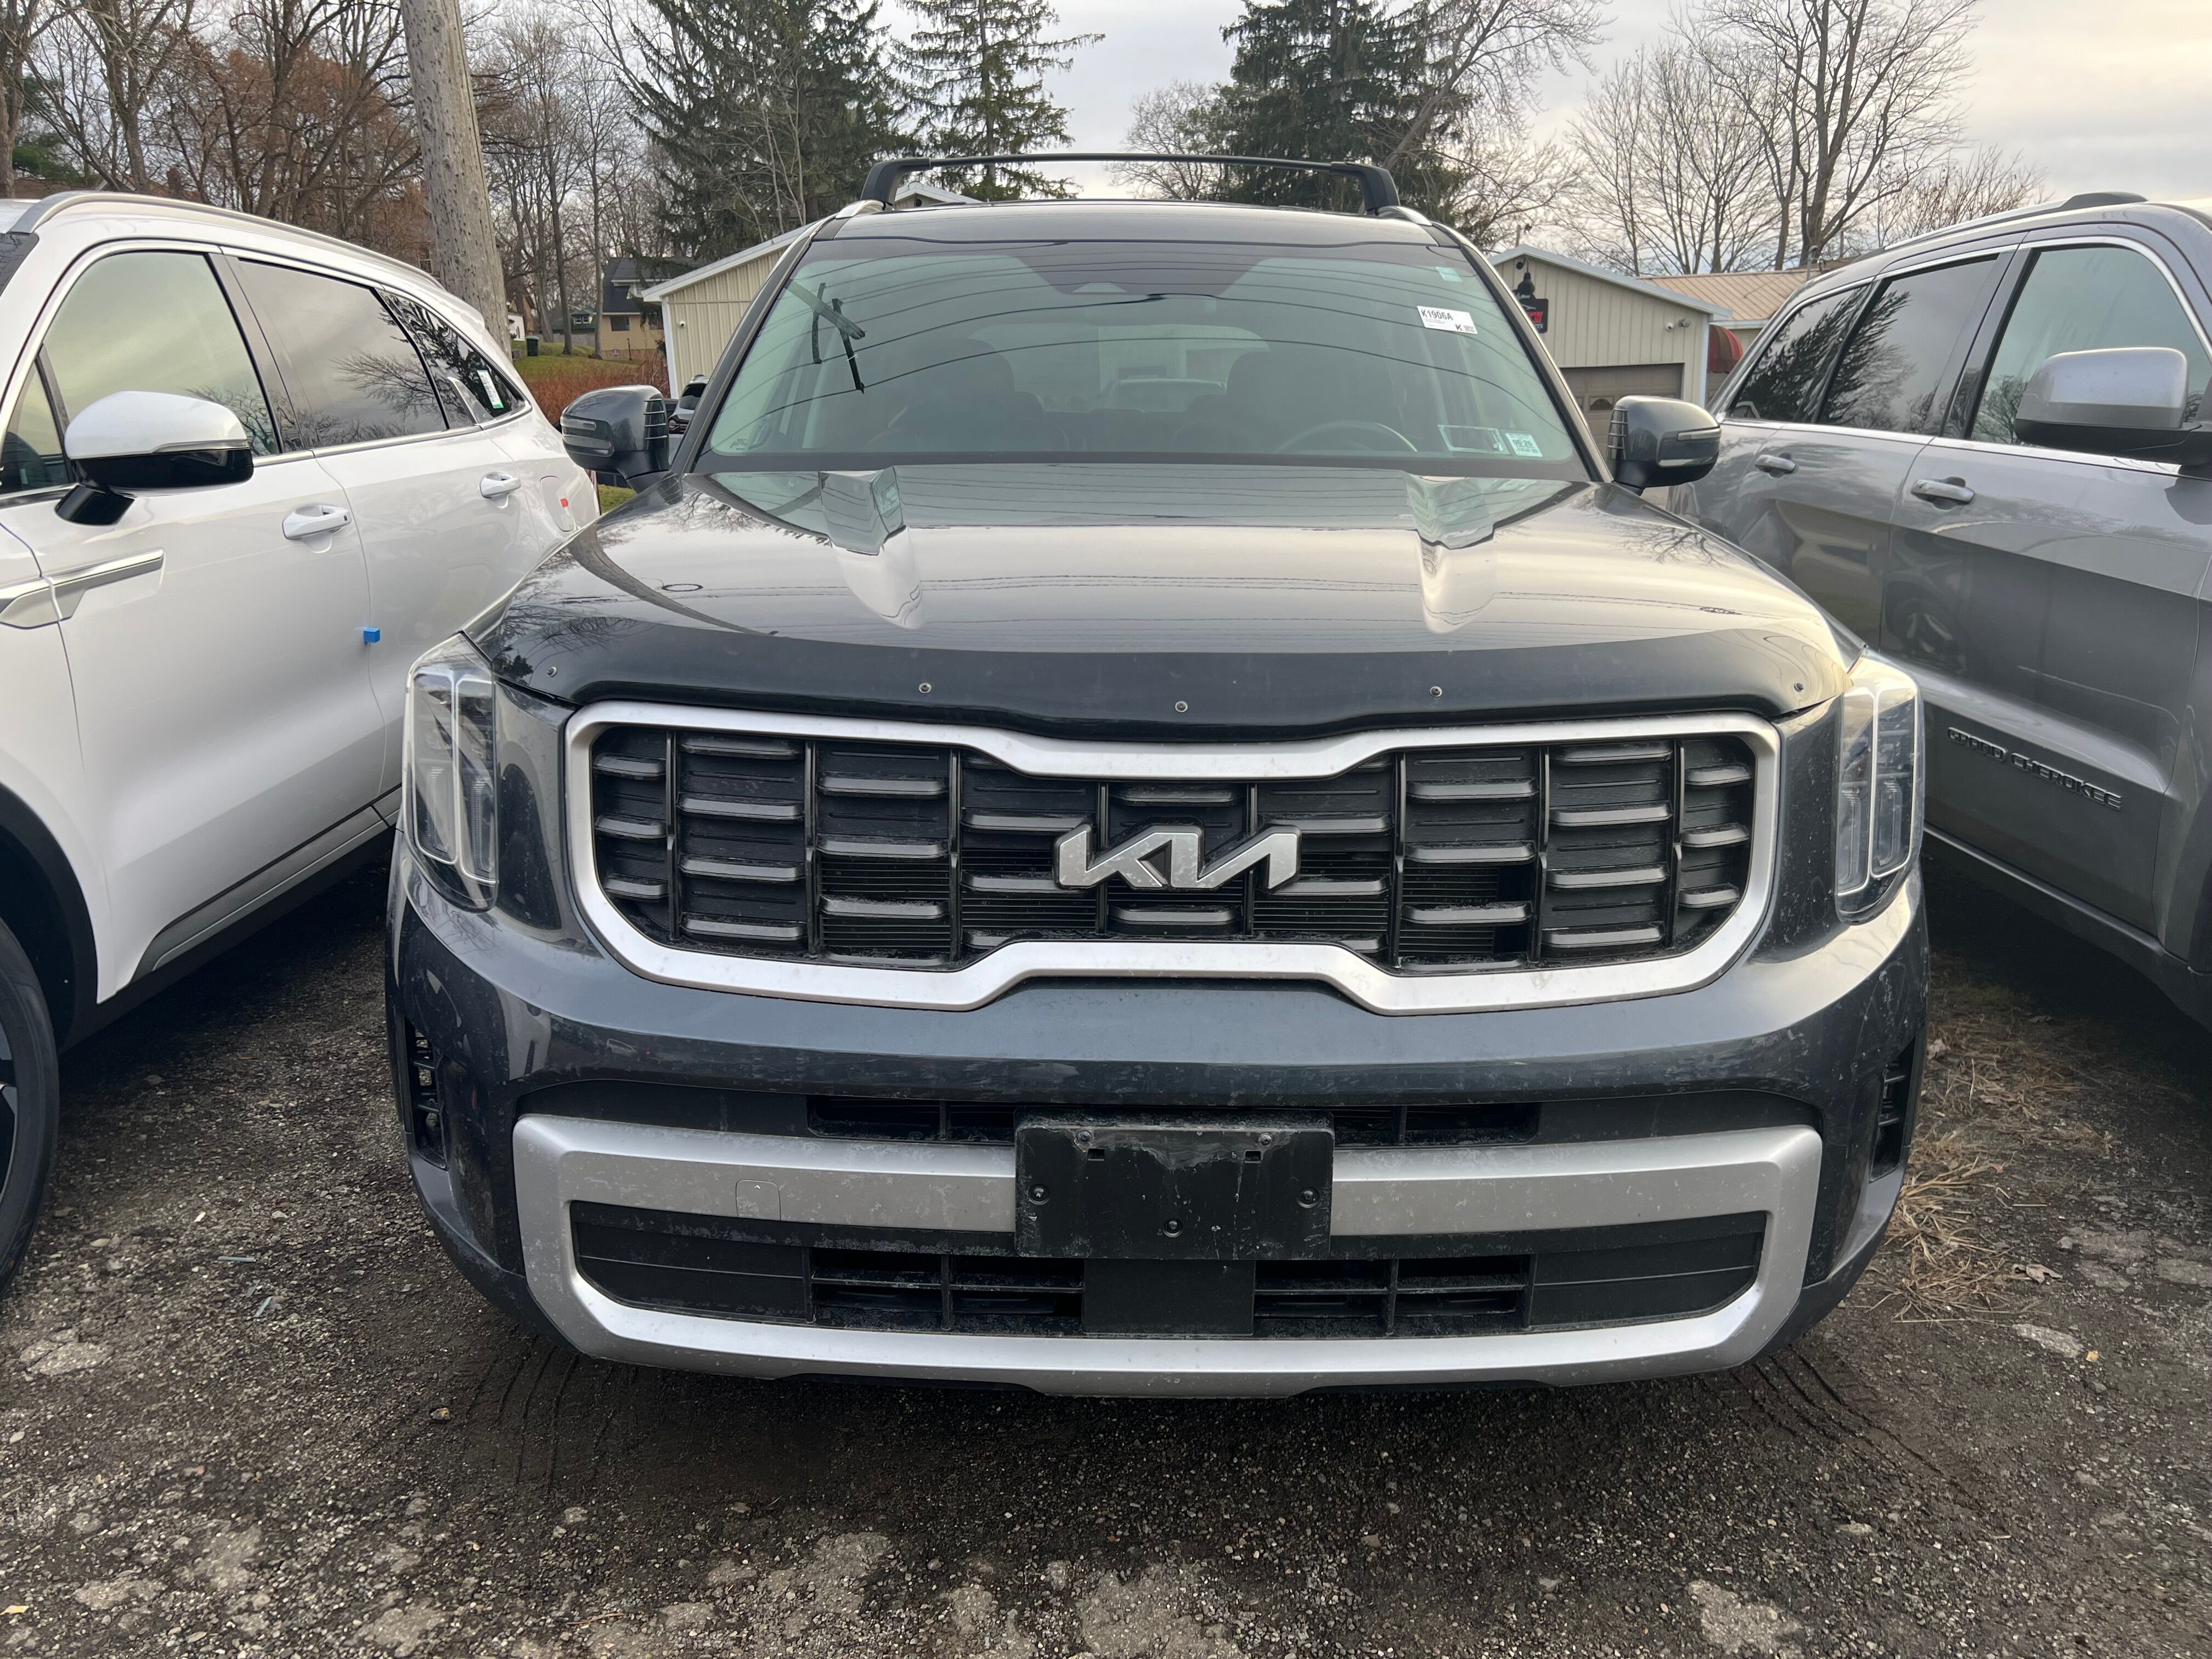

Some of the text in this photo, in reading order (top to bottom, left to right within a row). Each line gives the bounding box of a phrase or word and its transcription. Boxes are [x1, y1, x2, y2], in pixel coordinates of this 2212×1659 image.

[1421, 309, 1453, 320] K1906A
[1948, 727, 2124, 812] GRAND CHEROKEE
[1054, 823, 1301, 889] KIA
